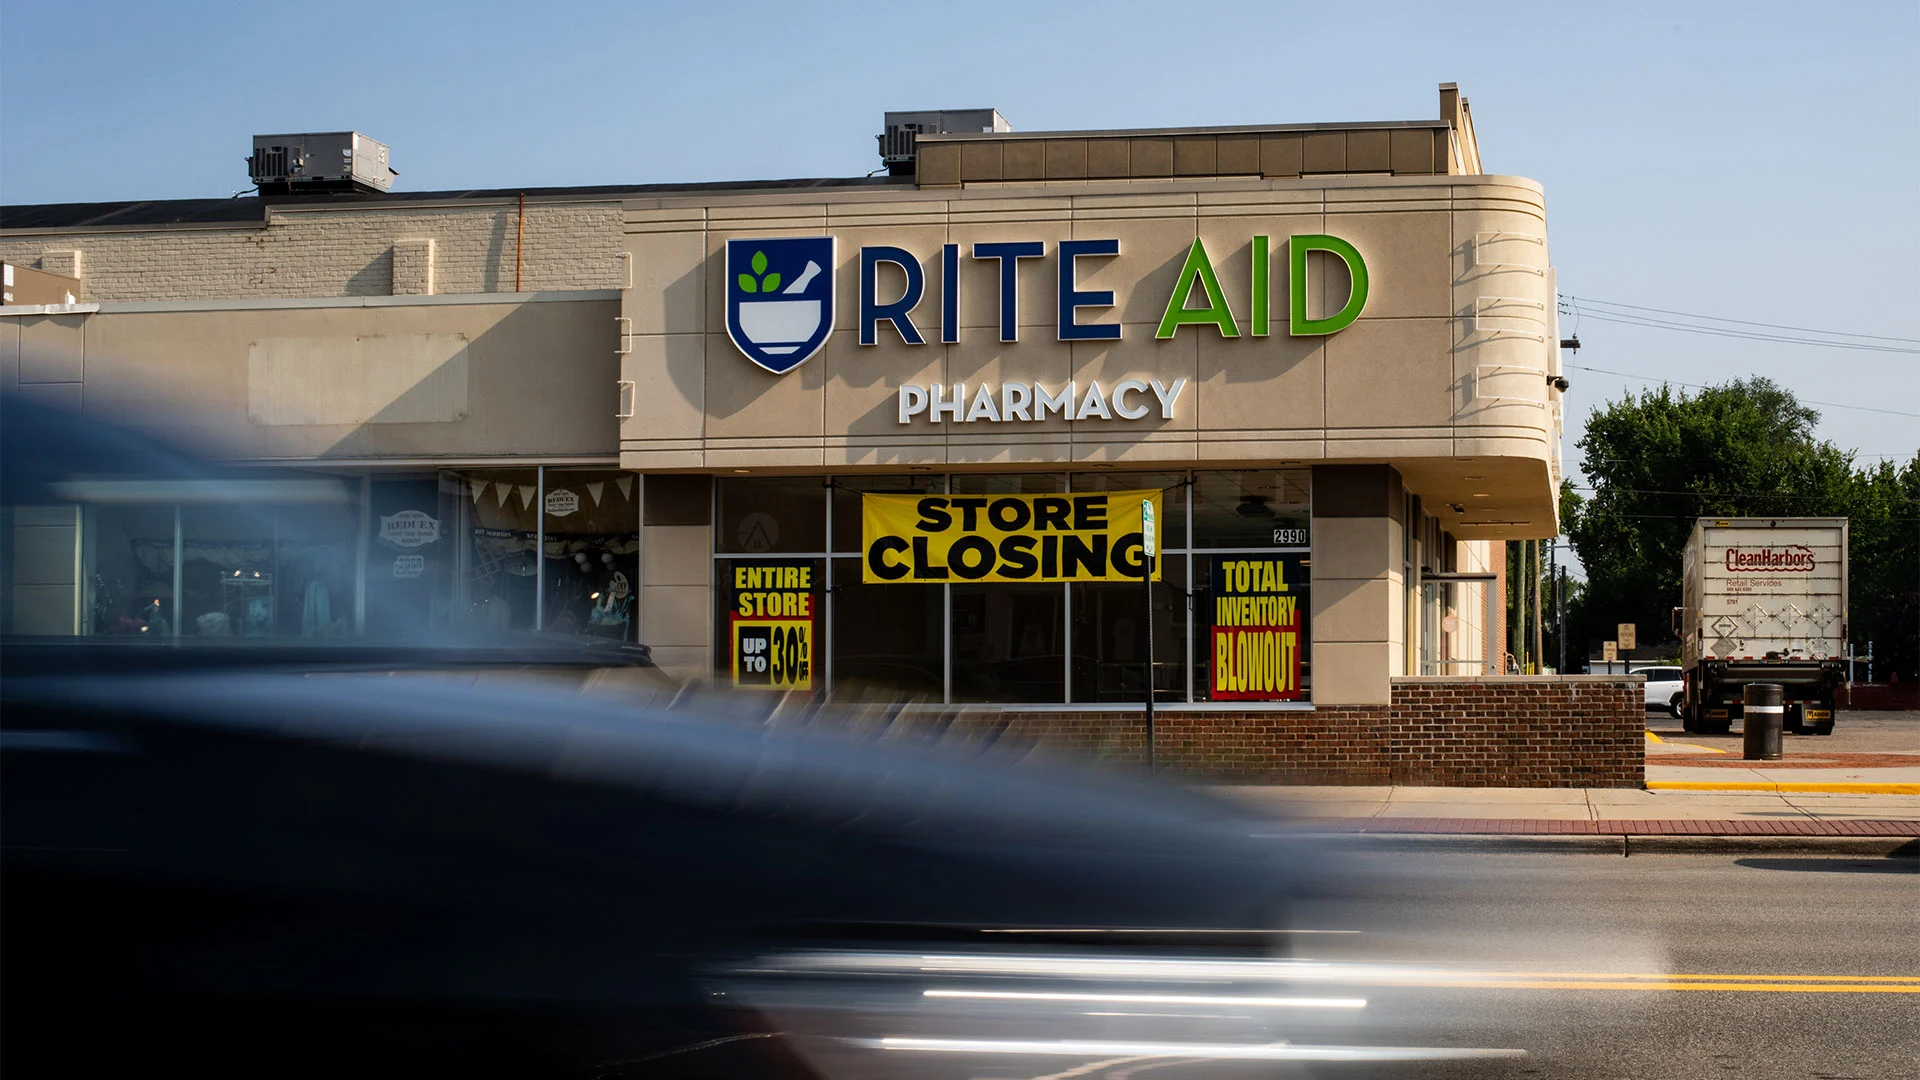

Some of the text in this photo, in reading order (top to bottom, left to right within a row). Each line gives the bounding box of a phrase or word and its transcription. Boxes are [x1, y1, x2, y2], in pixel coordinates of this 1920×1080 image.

[858, 234, 1369, 346] RITE AID
[898, 377, 1187, 425] PHARMACY
[916, 495, 1108, 532] STORE
[1275, 530, 1305, 543] 2990
[868, 533, 1155, 580] CLOSING
[735, 567, 811, 588] ENTIRE
[1222, 561, 1288, 592] TOTAL
[1726, 579, 1782, 587] Retail Services
[739, 592, 809, 616] STORE
[1216, 595, 1297, 627] INVENTORY
[743, 638, 767, 654] UP
[1216, 630, 1296, 693] BLOWOUT
[744, 656, 767, 672] TO
